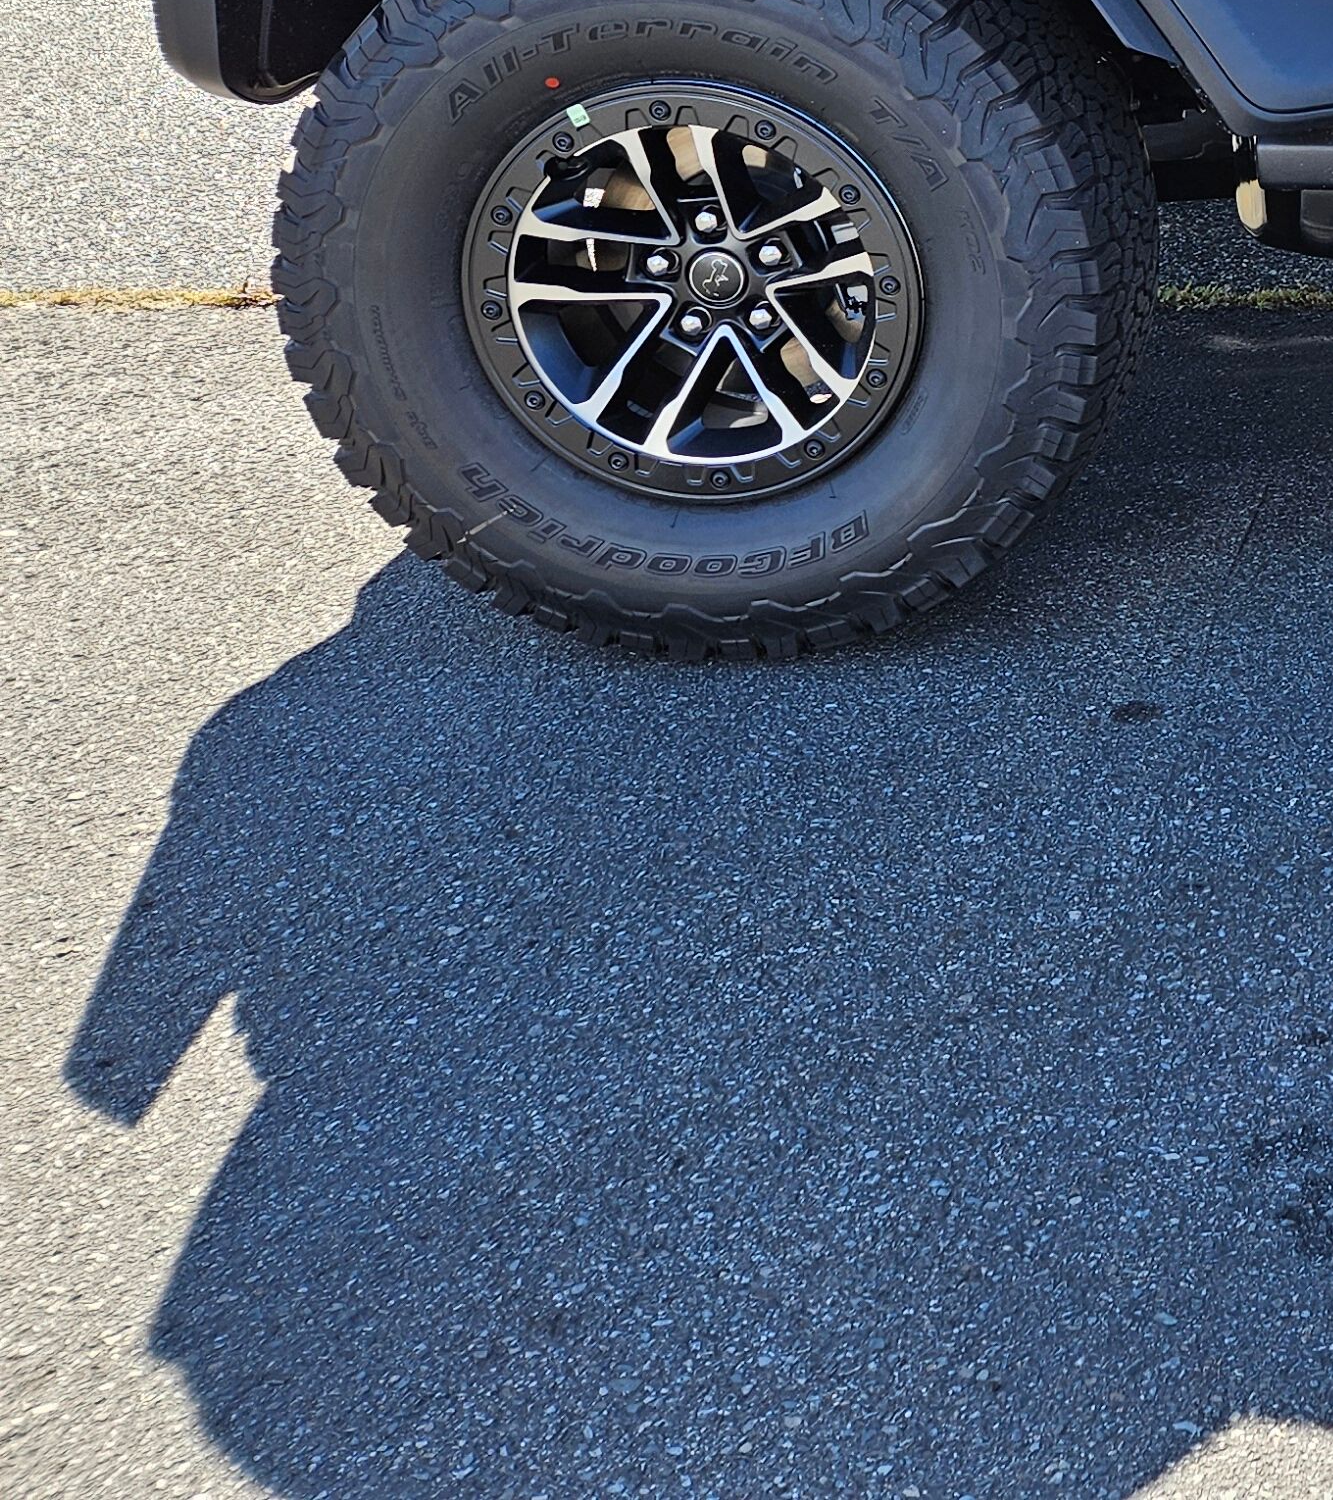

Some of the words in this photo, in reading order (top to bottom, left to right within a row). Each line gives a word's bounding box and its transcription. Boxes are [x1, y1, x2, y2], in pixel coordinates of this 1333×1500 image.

[446, 17, 840, 125] All-Terrain
[868, 94, 950, 192] T/A
[457, 461, 871, 579] BFGoodrich
